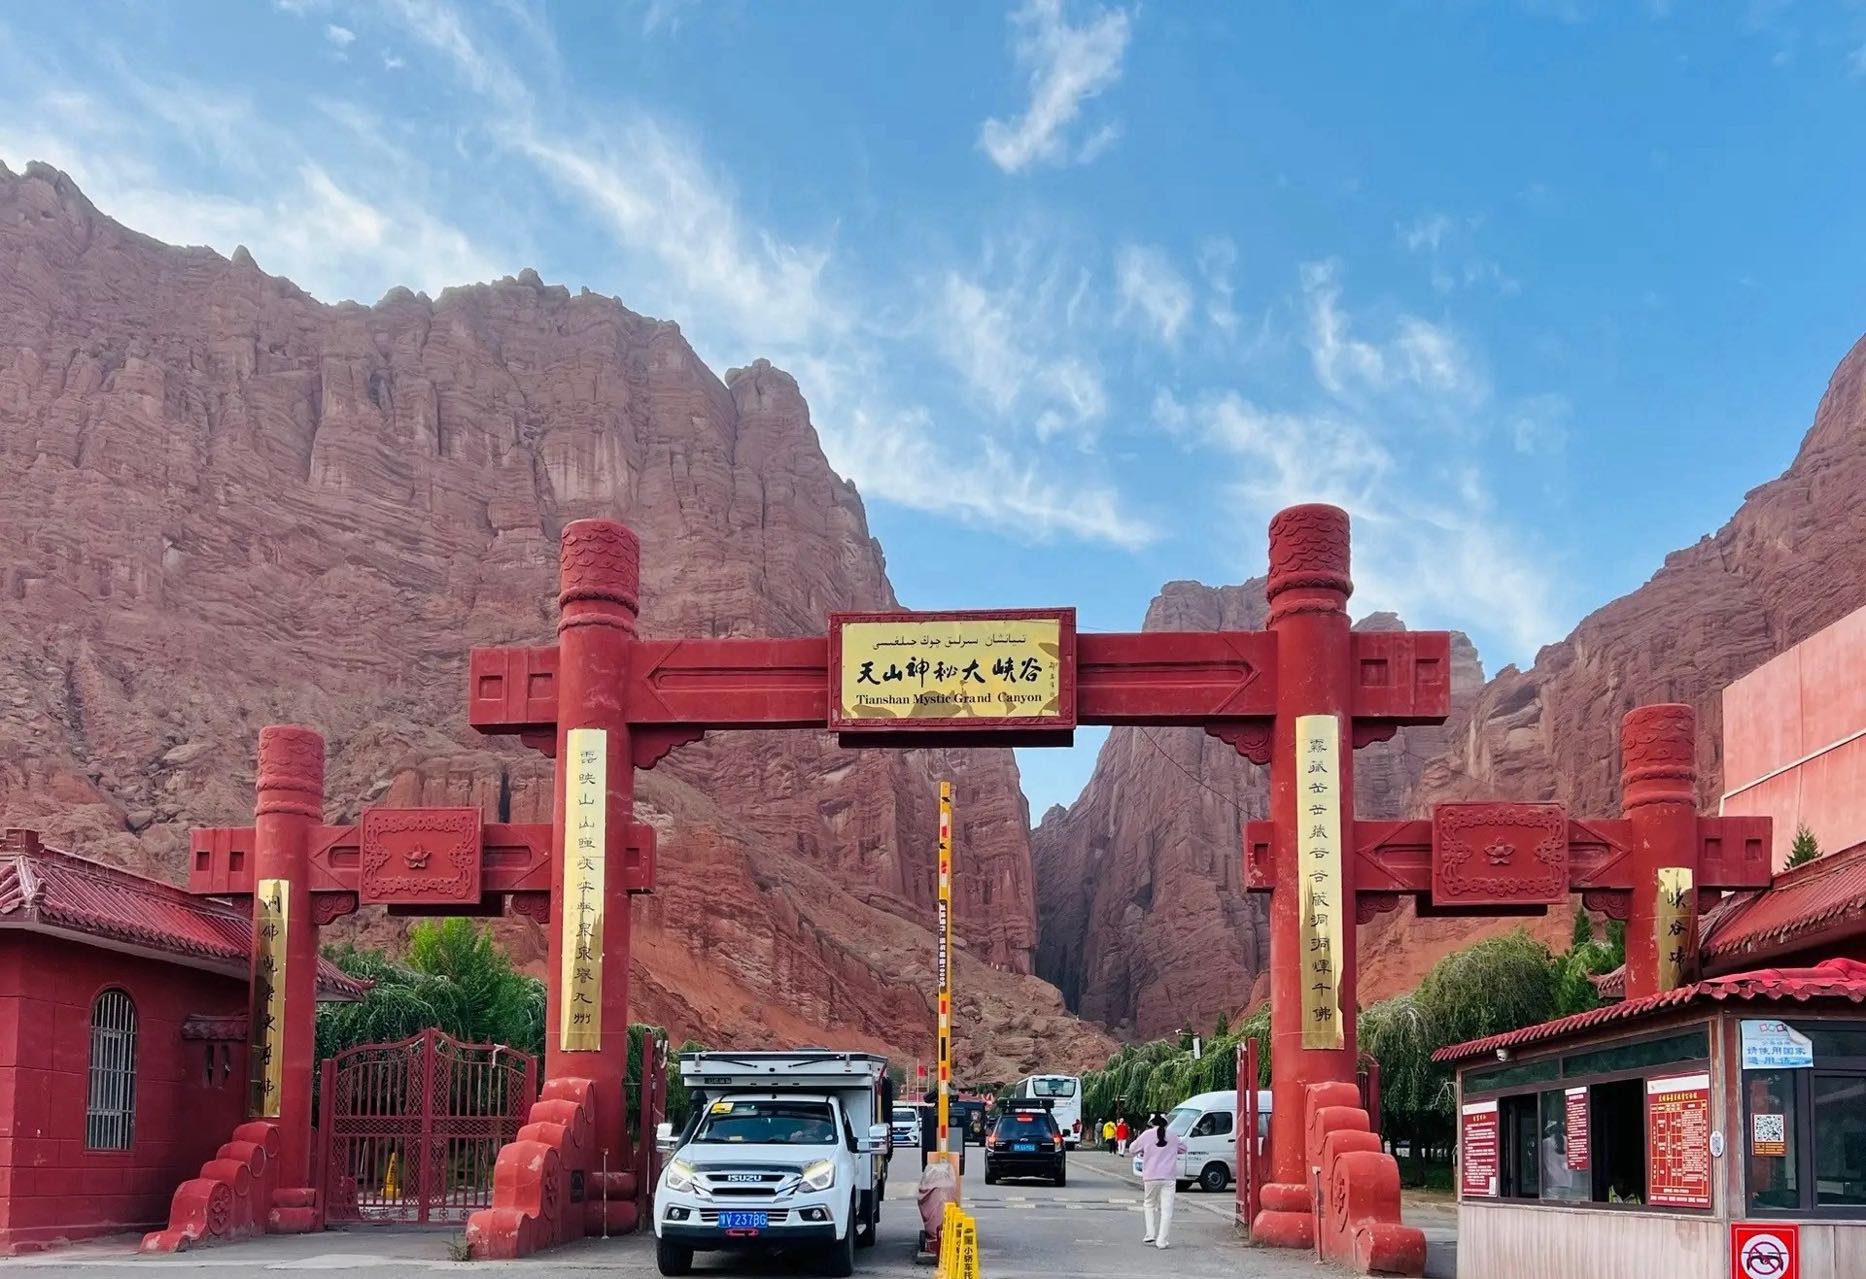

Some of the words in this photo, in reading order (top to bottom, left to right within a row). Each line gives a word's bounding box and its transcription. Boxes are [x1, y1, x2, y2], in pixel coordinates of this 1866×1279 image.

[857, 656, 1042, 688] 天山神秘大峡谷
[856, 693, 910, 705] Tianshan
[912, 692, 951, 705] Mystic
[954, 692, 991, 704] Grand
[997, 691, 1042, 704] Canyon
[728, 1174, 762, 1182] ISUZU
